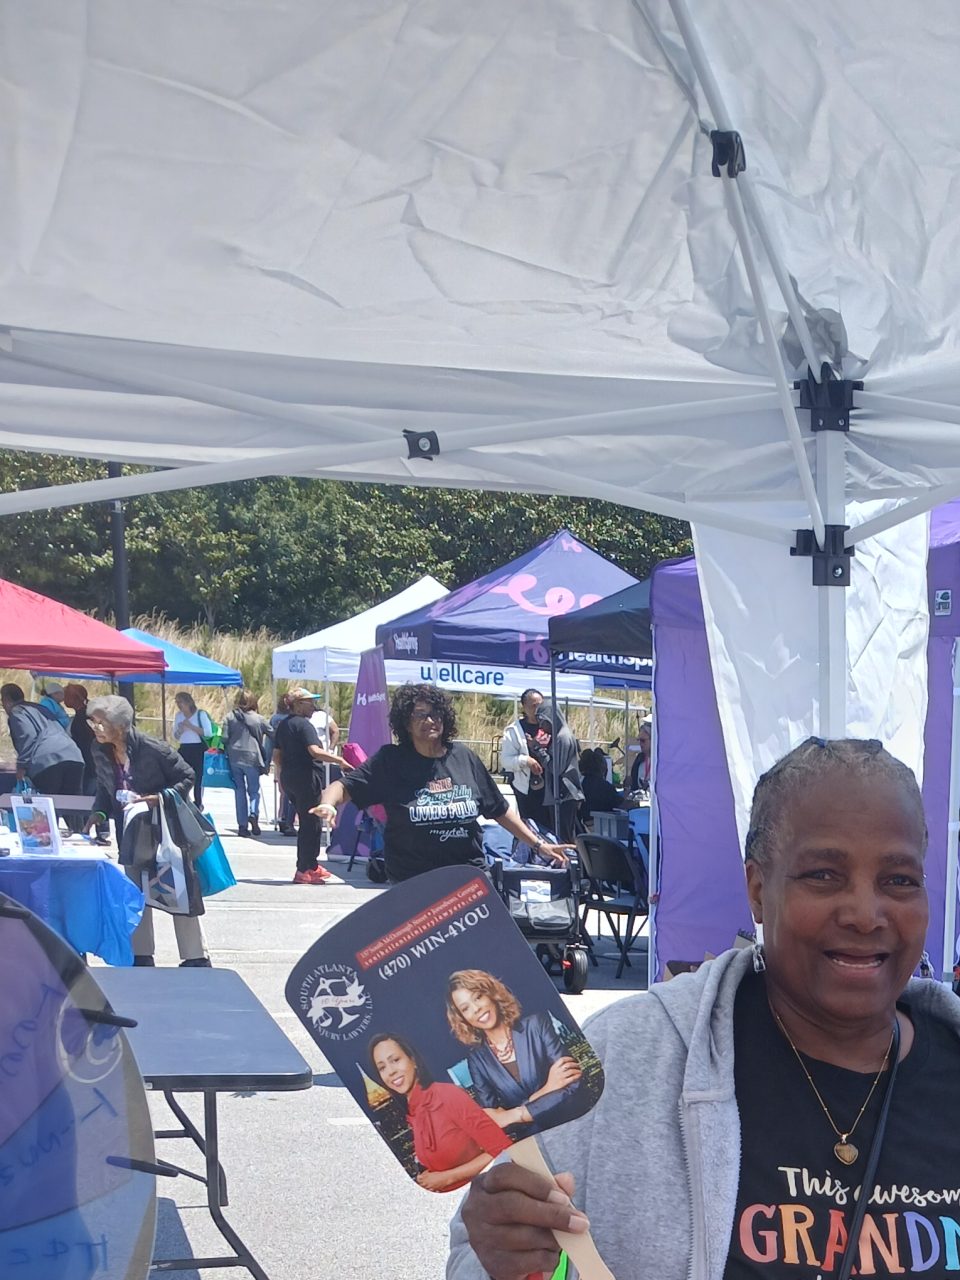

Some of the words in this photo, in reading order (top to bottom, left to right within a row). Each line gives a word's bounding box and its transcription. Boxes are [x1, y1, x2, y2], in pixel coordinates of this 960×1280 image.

[420, 662, 505, 687] wellcare
[377, 952, 412, 981] (470)
[409, 902, 491, 960] WIN-4YOU
[776, 1165, 852, 1206] This
